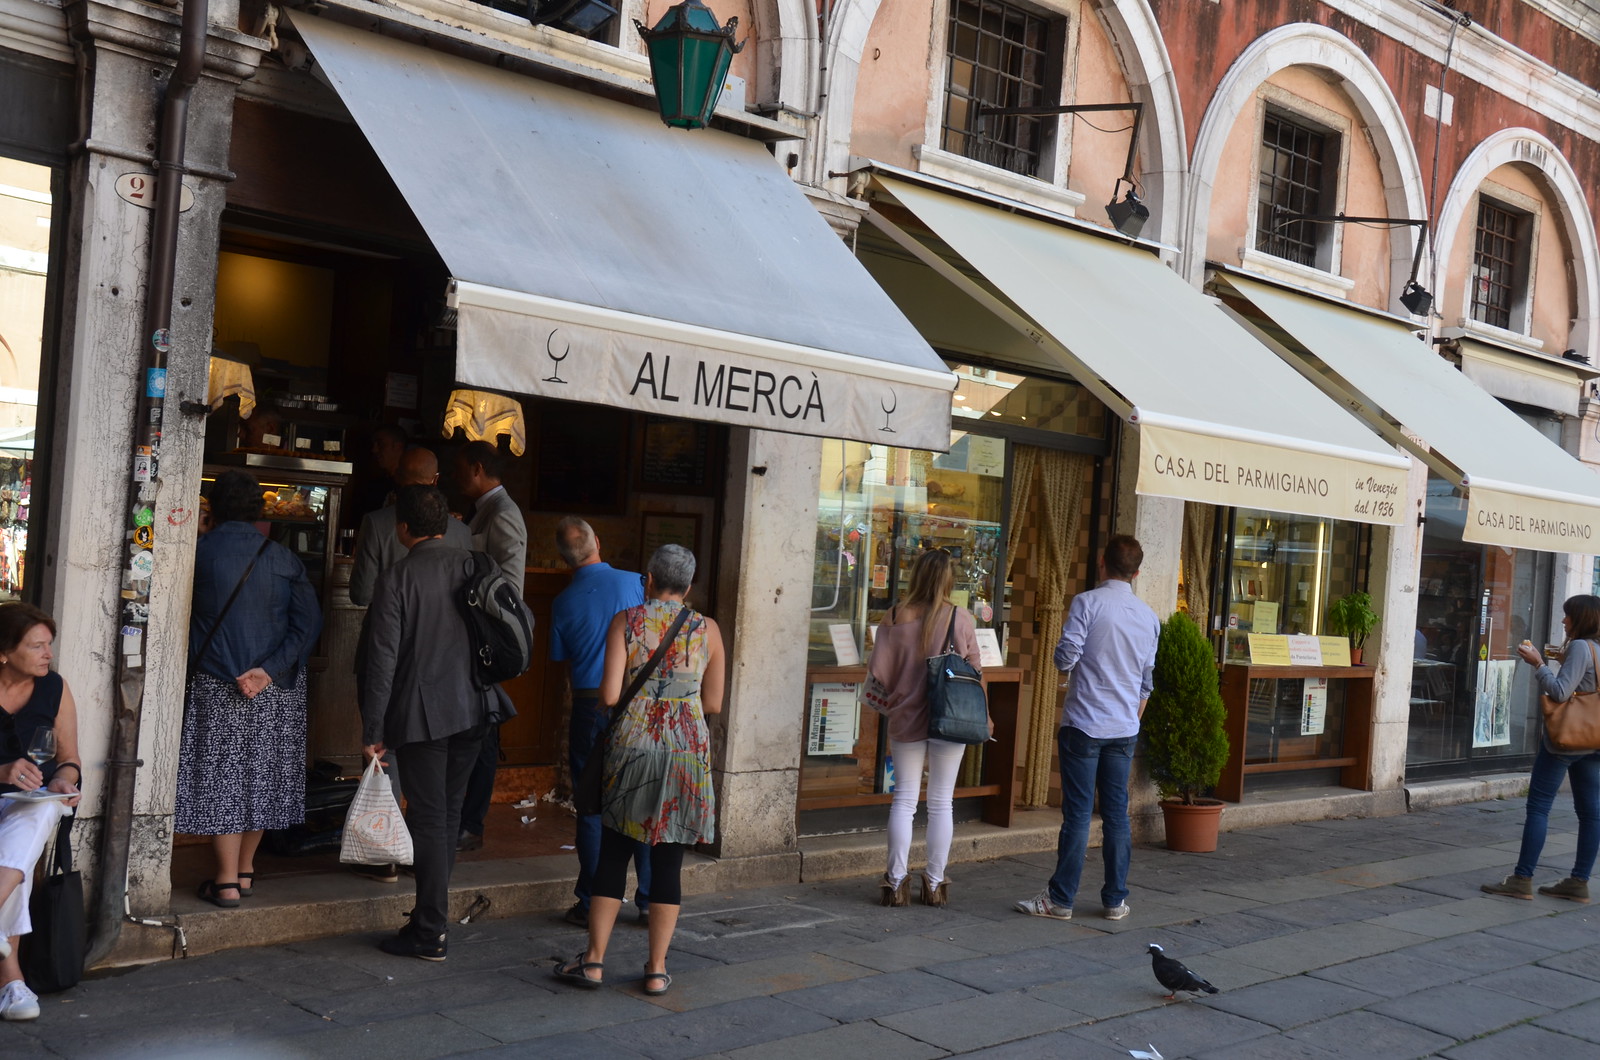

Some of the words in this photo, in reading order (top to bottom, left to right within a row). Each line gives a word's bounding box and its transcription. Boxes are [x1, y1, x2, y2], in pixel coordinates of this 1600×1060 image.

[630, 351, 680, 402] AL
[693, 360, 826, 423] MERCÀ
[1154, 454, 1197, 480] CASA
[1204, 461, 1230, 484] DEL
[1237, 466, 1329, 497] PARMIGIANO
[1355, 477, 1364, 491] in
[1366, 476, 1398, 496] Venezia
[1354, 499, 1369, 515] dal
[1371, 500, 1394, 518] 1936
[1477, 510, 1505, 529] CASA
[1508, 514, 1526, 532] DEL
[1529, 517, 1592, 540] PARMIGIANO
